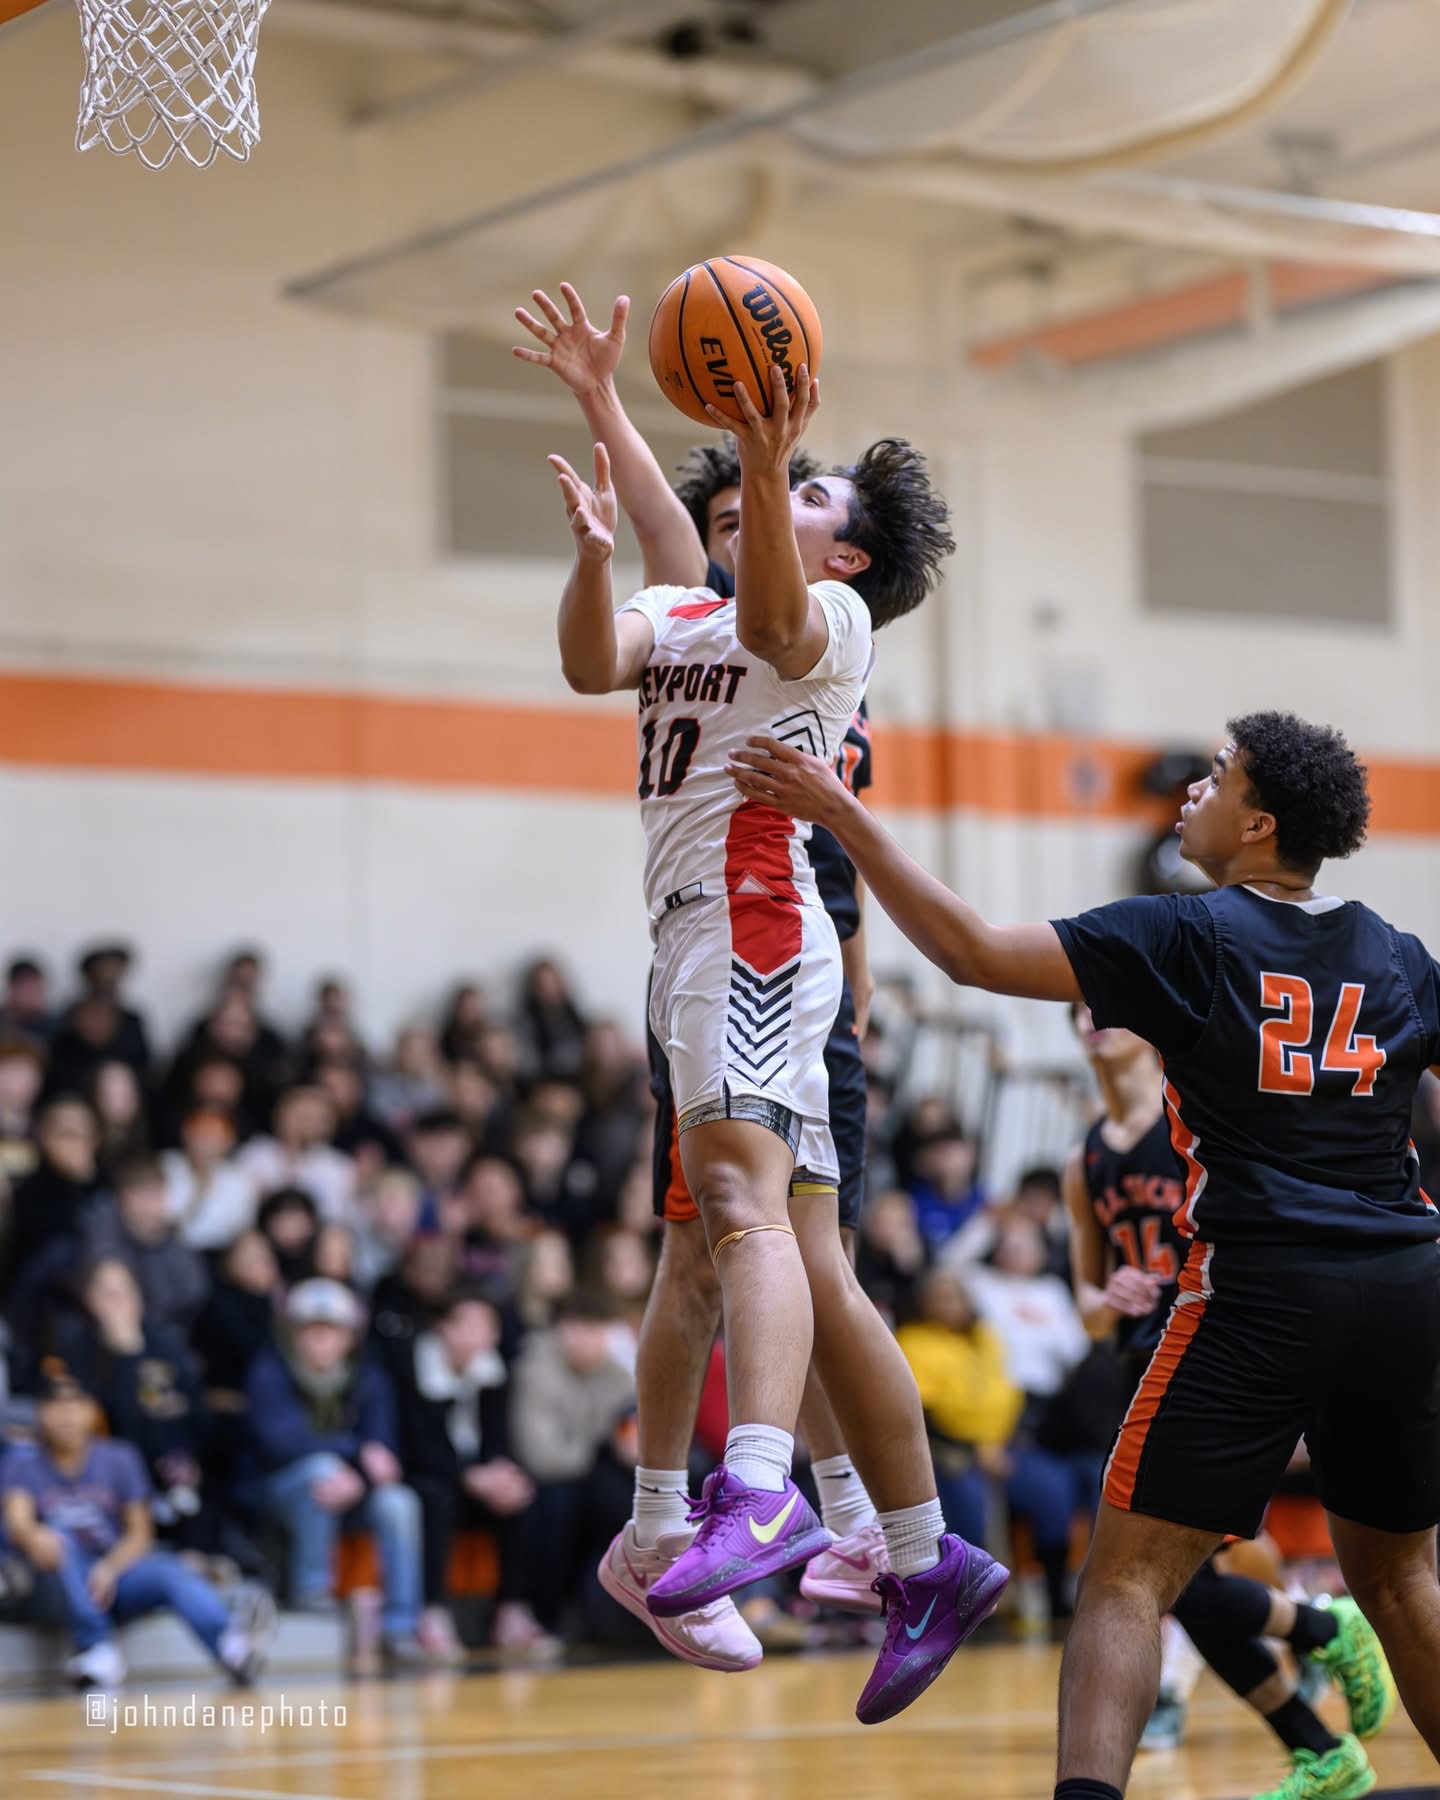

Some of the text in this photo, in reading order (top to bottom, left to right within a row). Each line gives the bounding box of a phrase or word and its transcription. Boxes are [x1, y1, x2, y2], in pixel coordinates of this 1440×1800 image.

[639, 664, 748, 714] EYPORT
[639, 717, 702, 800] 10
[1258, 970, 1388, 1097] 24
